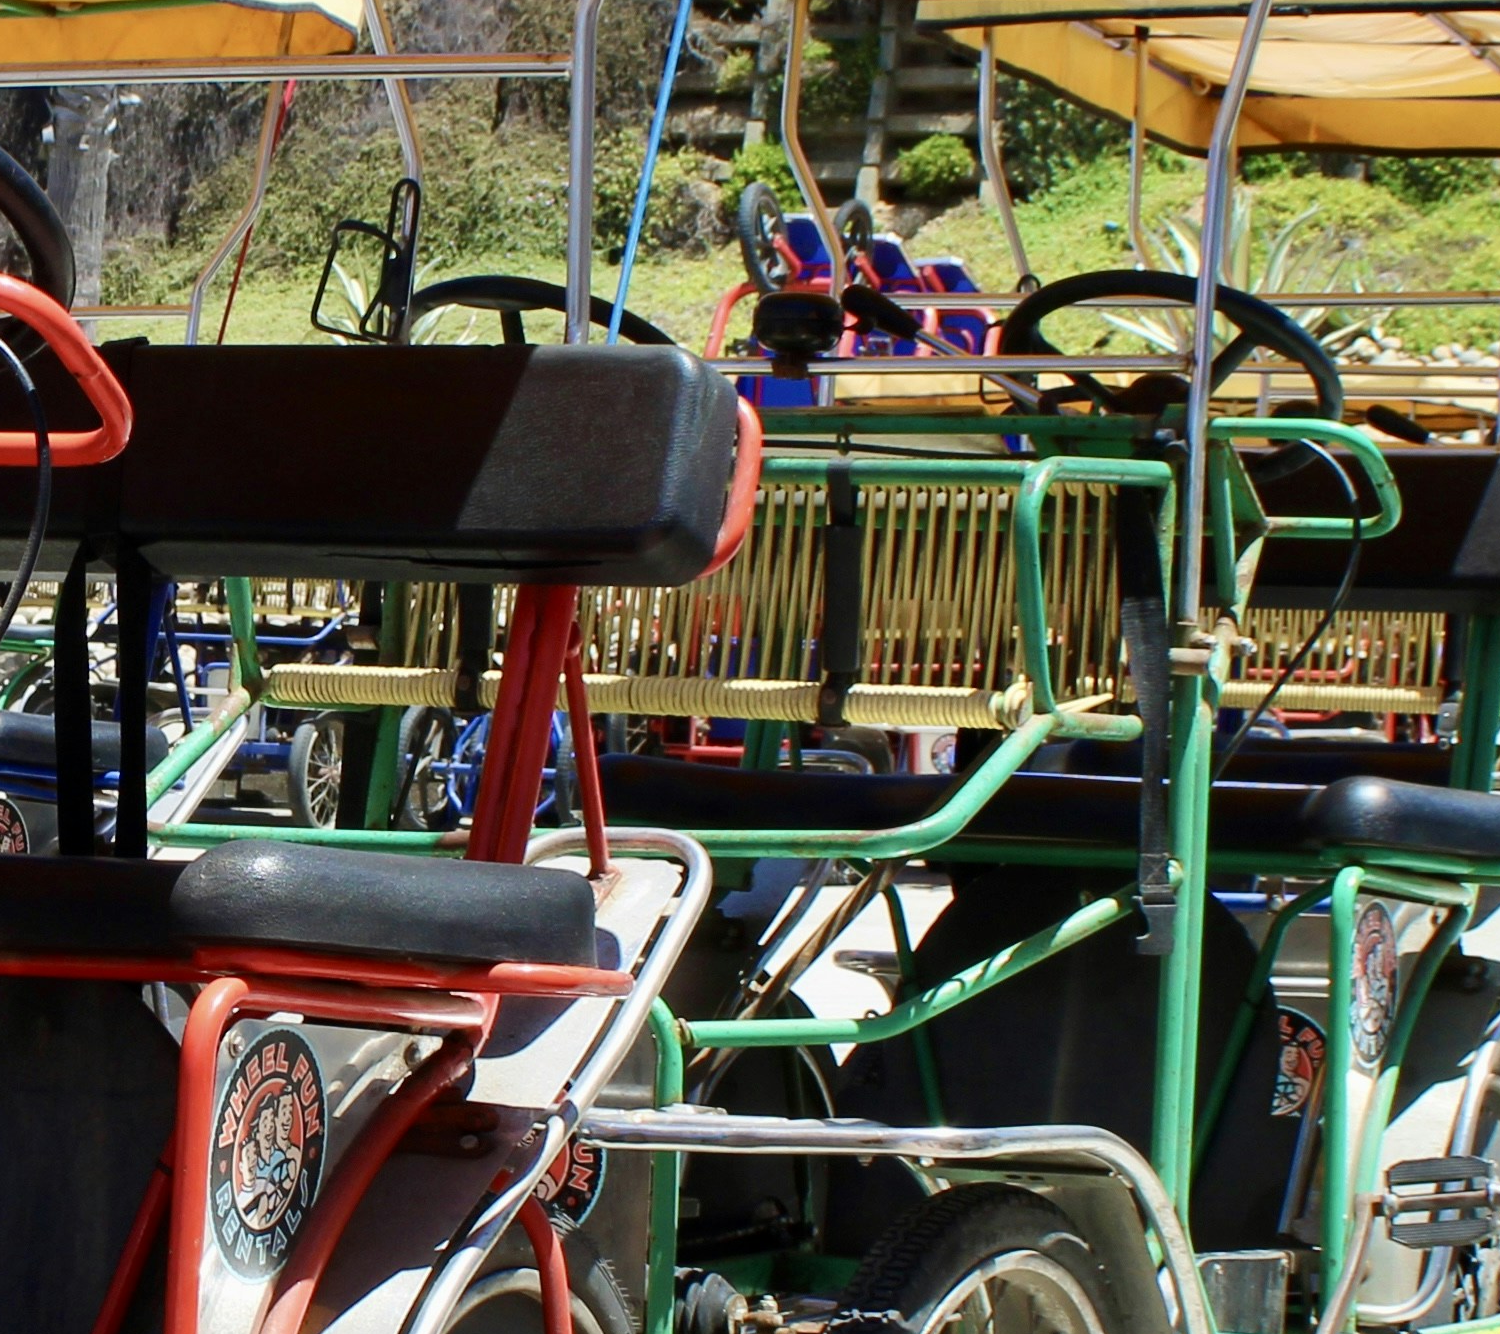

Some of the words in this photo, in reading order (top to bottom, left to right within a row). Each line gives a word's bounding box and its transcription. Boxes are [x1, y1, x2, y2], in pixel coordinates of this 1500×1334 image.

[218, 1042, 290, 1148] WHEEL
[291, 1053, 322, 1139] FUN
[215, 1168, 309, 1266] RENTALS
